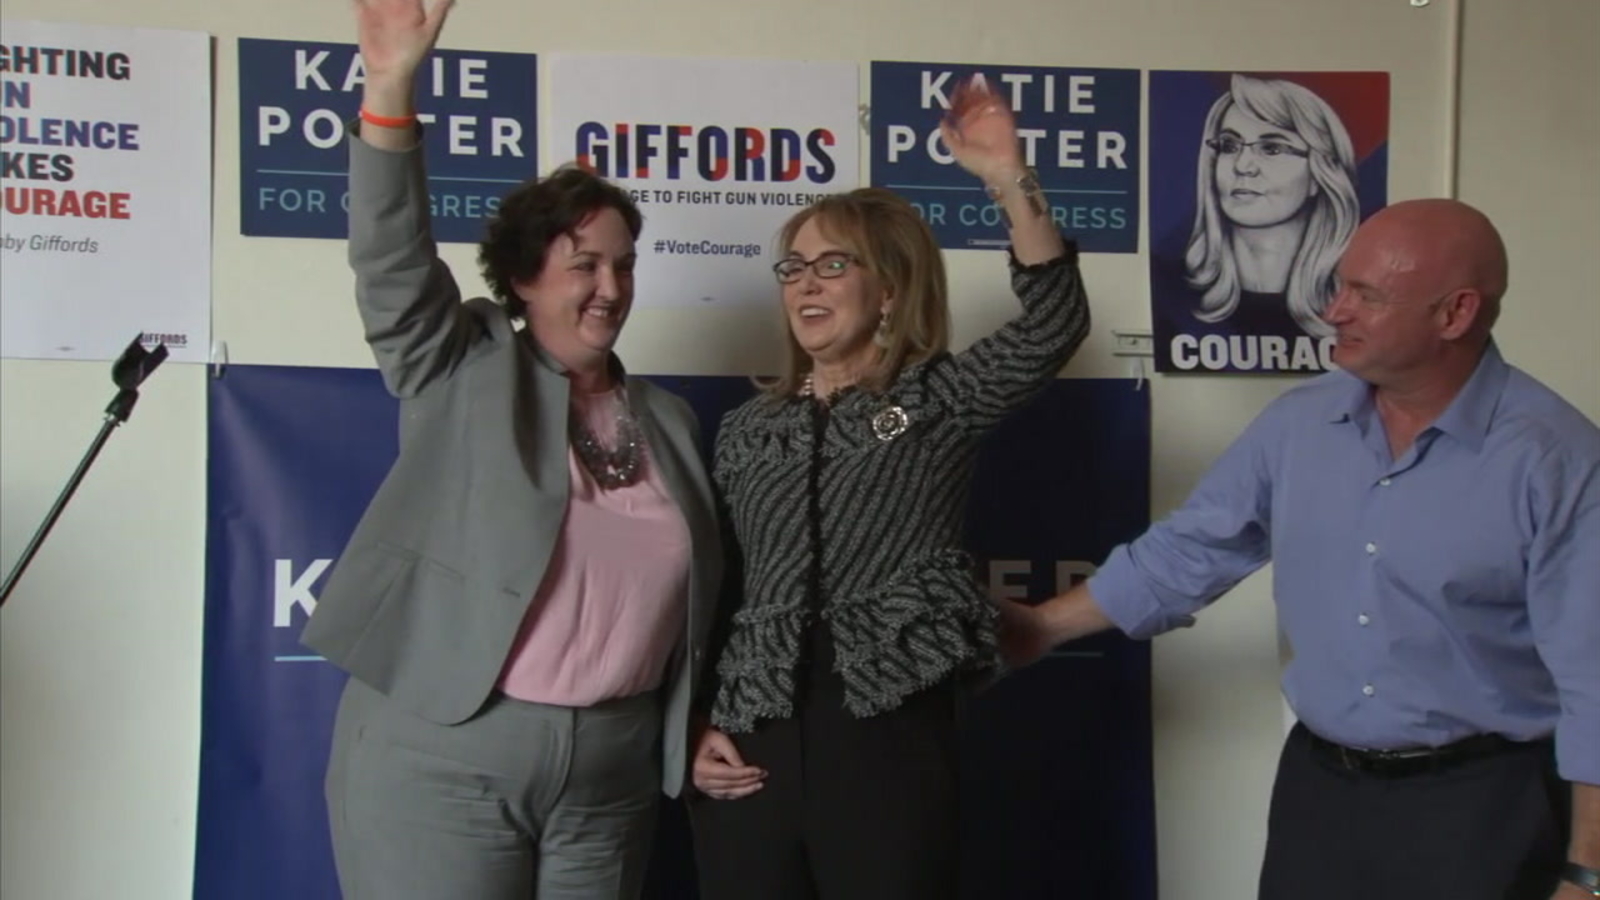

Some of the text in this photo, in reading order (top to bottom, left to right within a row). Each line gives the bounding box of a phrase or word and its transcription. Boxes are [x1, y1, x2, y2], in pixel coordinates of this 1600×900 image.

[295, 50, 488, 98] KAIE
[259, 106, 525, 157] POER
[575, 122, 836, 184] GIFFORDS
[887, 125, 1127, 169] POTER
[0, 187, 131, 220] URAGE
[259, 188, 326, 212] FOR
[653, 190, 672, 203] TO
[677, 191, 720, 204] FIGHT
[725, 192, 756, 205] GUN
[760, 192, 831, 206] VIOLENC
[908, 203, 1126, 229] OR CORESS
[29, 235, 99, 254] Giffords
[653, 239, 761, 258] #VoteCourage
[139, 333, 188, 345] IFFORDS
[1170, 333, 1337, 371] COURA
